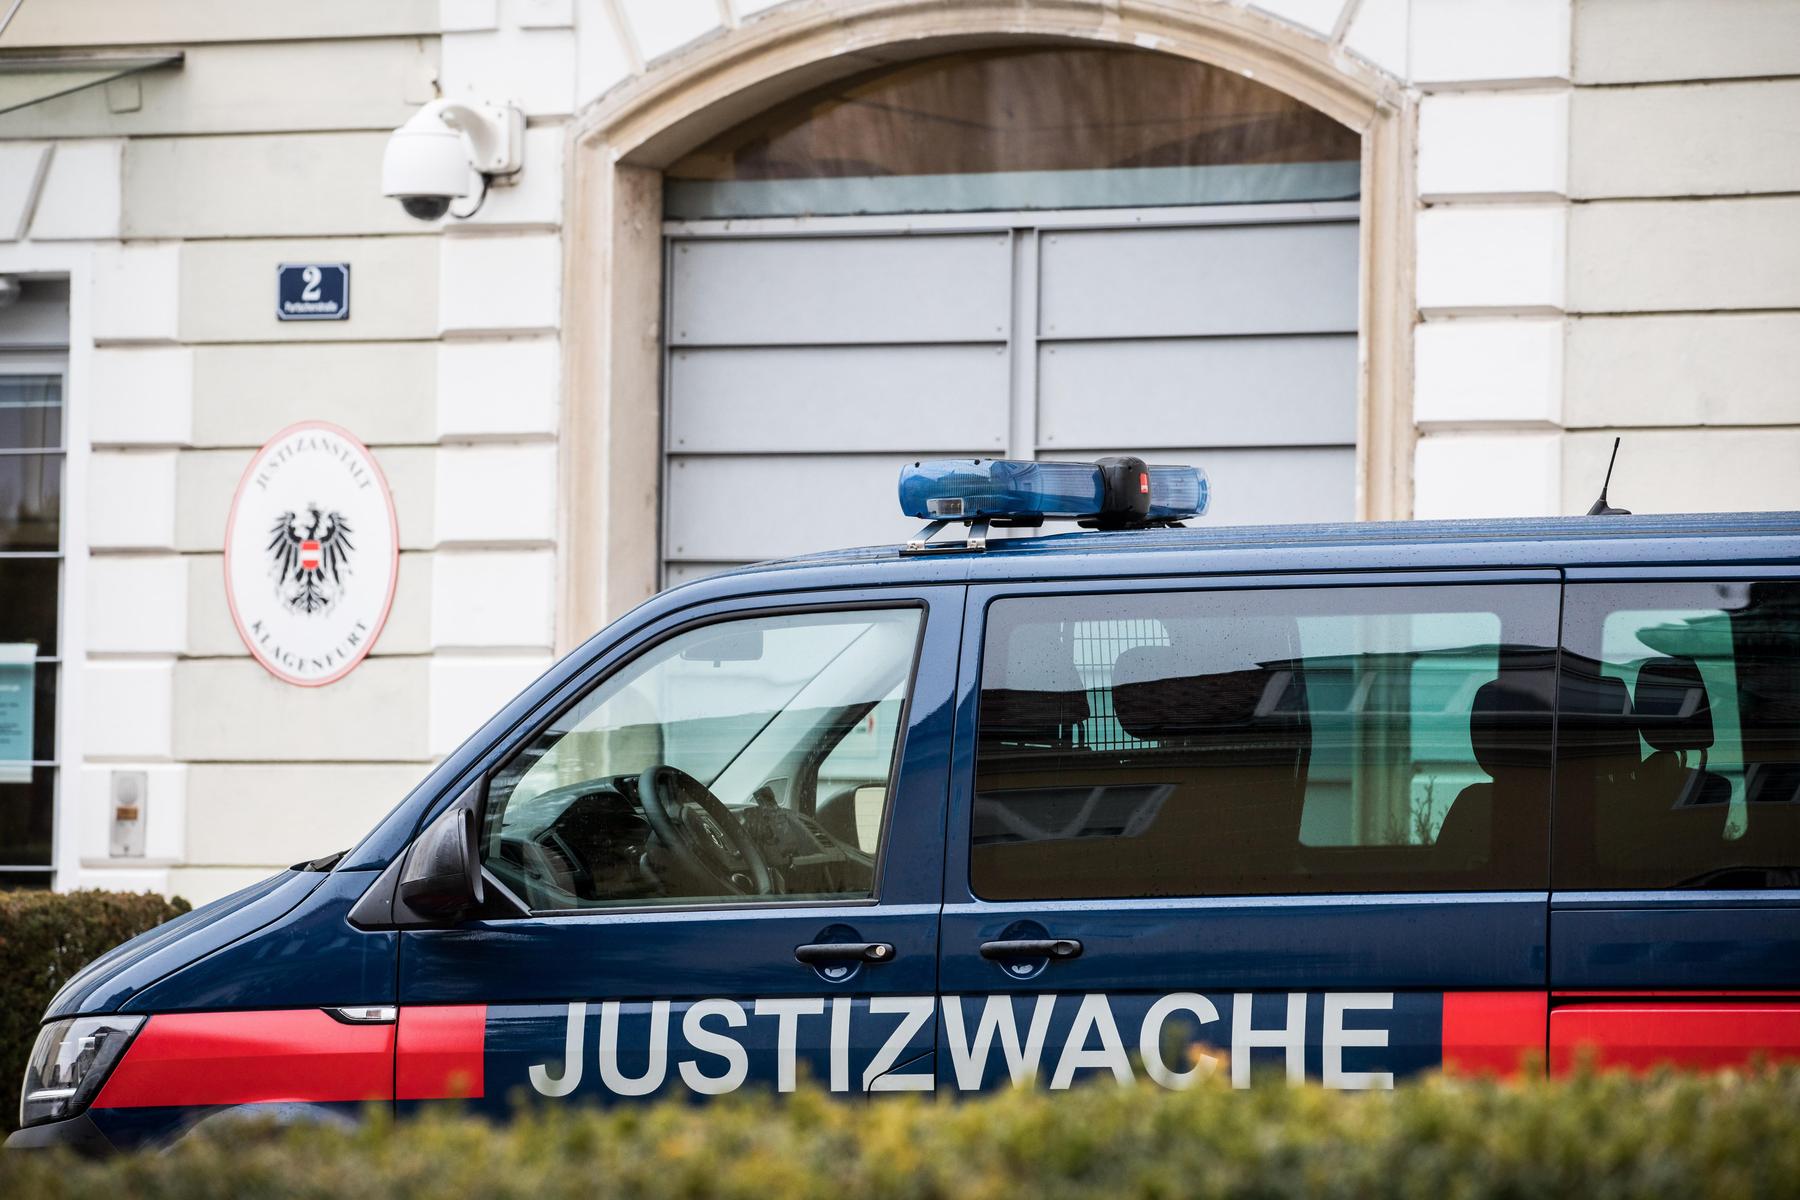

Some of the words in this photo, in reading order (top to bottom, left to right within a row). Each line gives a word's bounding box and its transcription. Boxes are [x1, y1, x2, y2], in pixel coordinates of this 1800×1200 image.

[301, 265, 322, 301] 2
[255, 437, 372, 491] JUSTIZANSTALT
[251, 618, 367, 672] KLAGENFURT
[528, 992, 1395, 1098] JUSTIZWACHE
